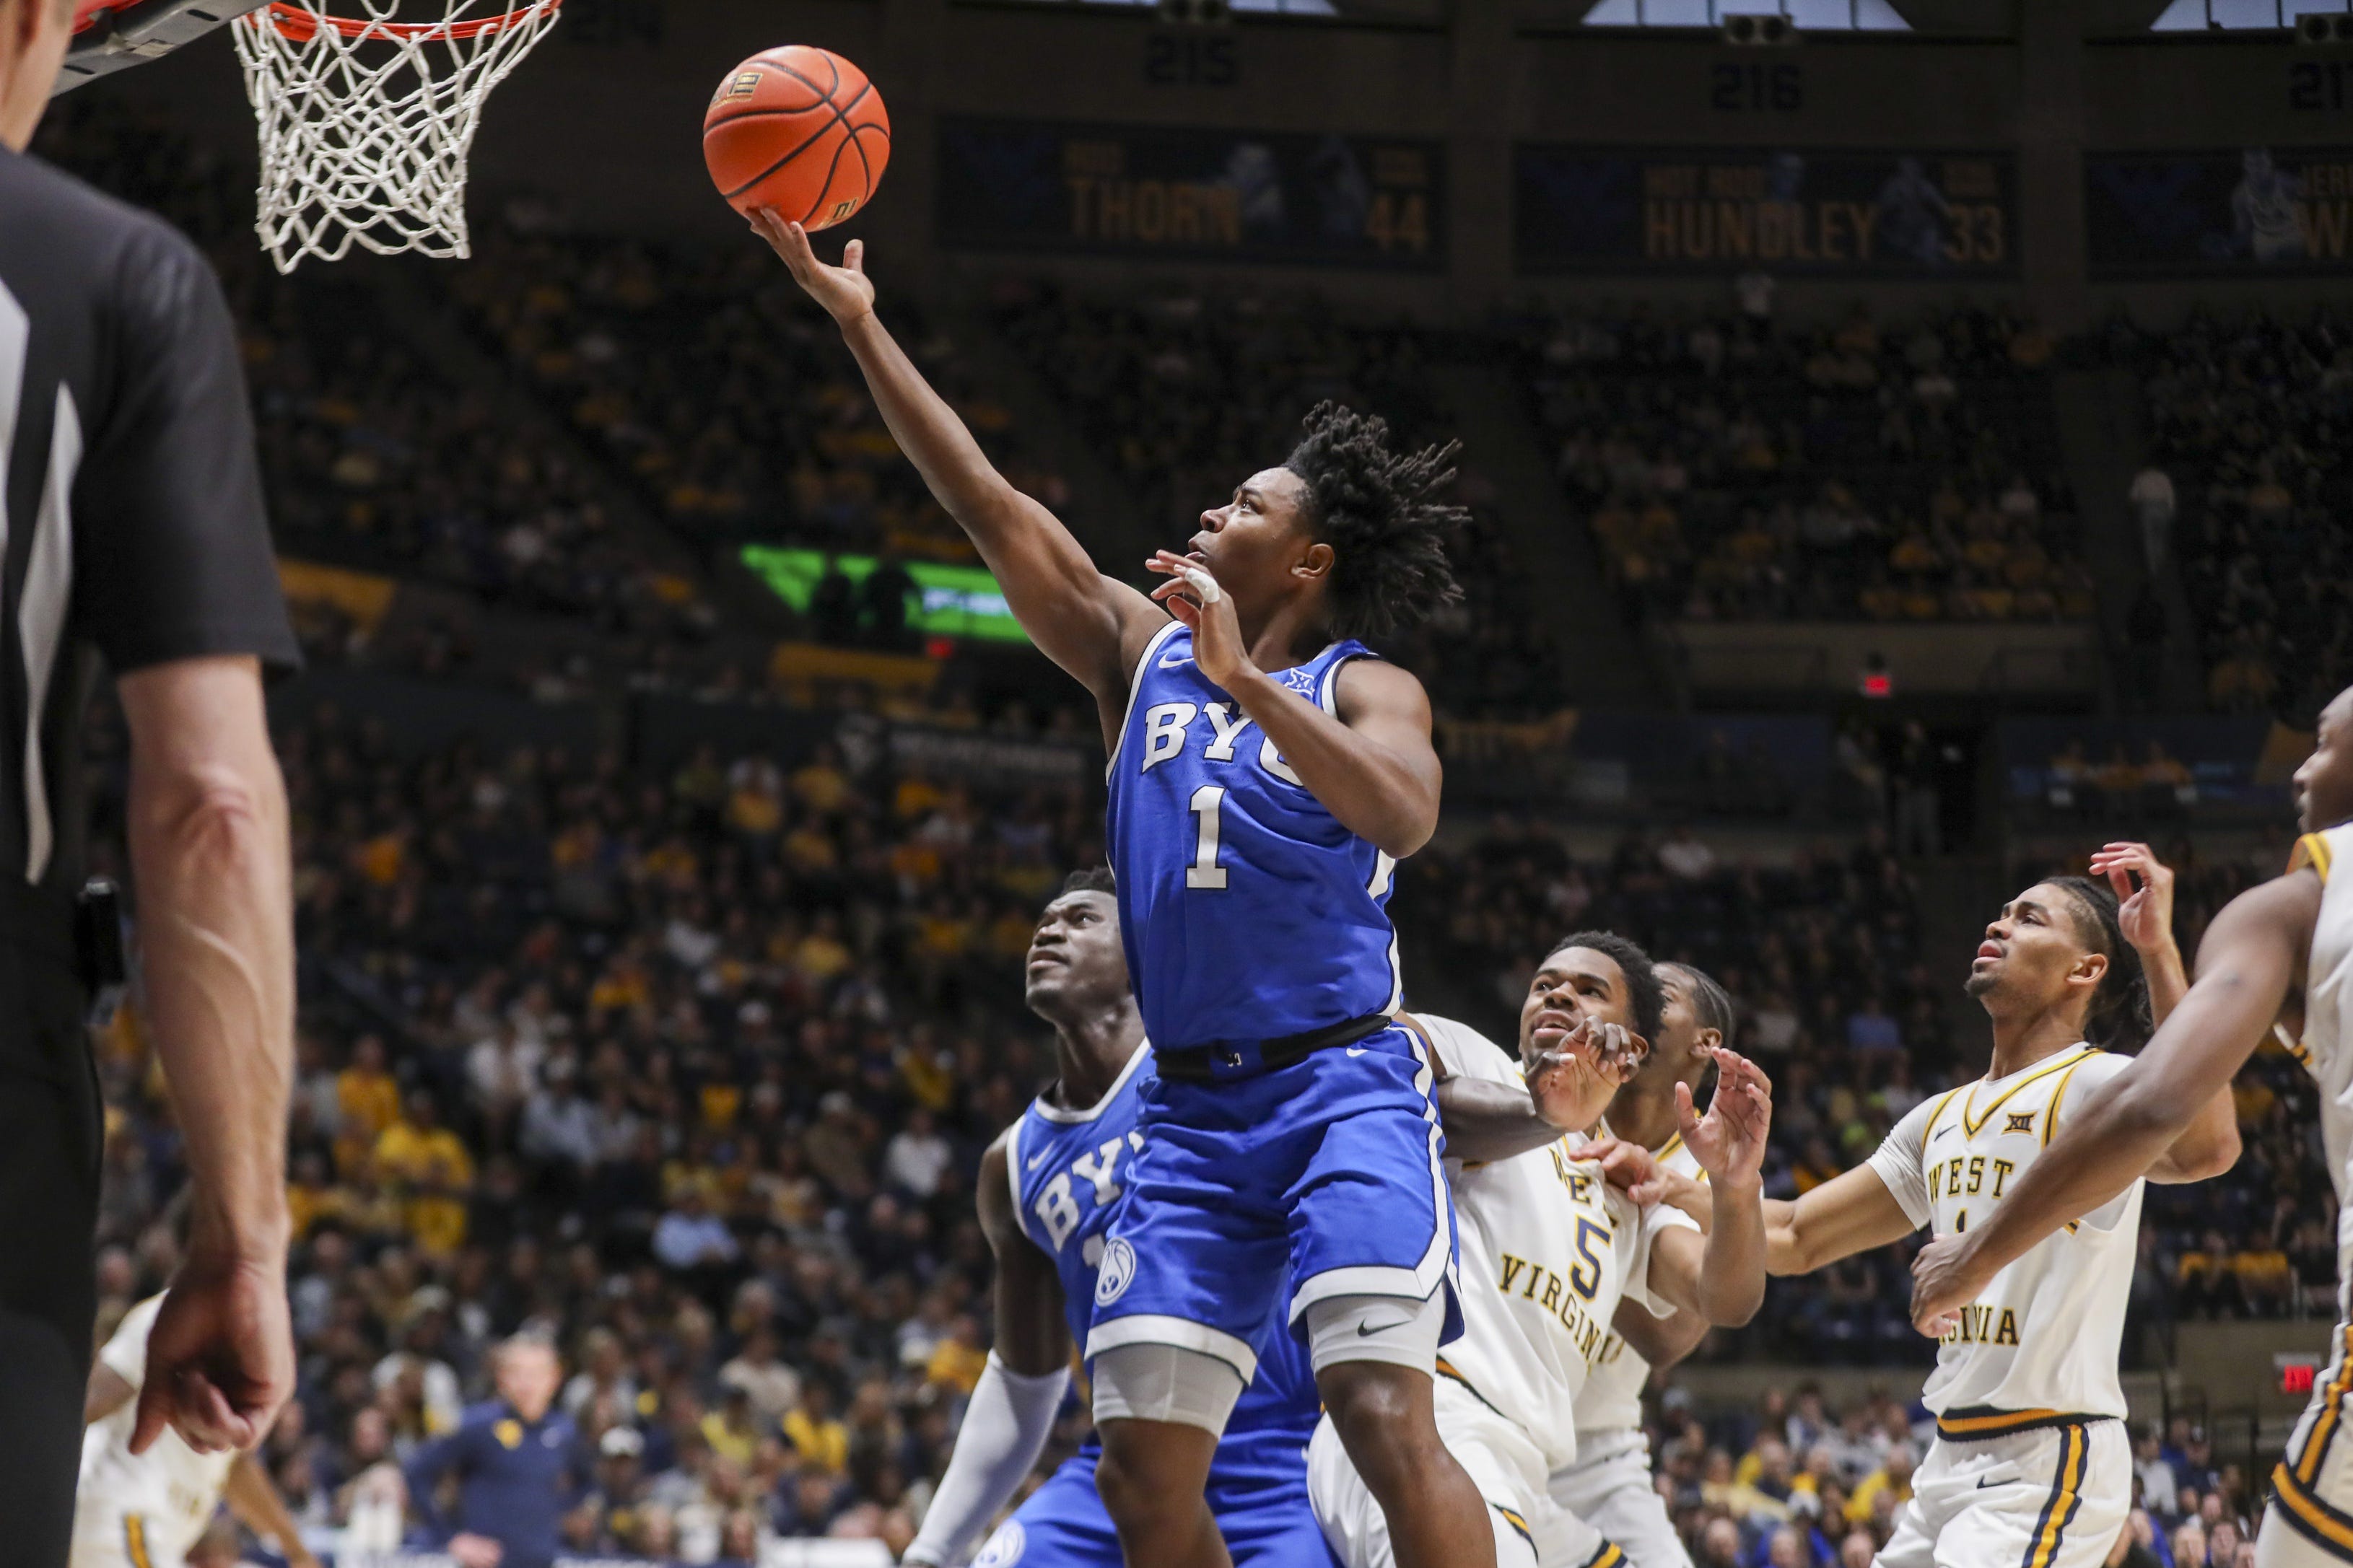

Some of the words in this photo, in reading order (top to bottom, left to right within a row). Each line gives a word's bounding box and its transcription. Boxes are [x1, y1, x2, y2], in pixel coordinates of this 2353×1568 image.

[1145, 33, 1238, 86] 215
[1710, 63, 1802, 111] 216
[2288, 60, 2353, 110] 21
[1065, 176, 1242, 245] THORN
[1363, 190, 1430, 253] 44
[1643, 198, 1882, 261] HUNDLEY
[1945, 202, 2007, 263] 33
[1186, 784, 1228, 889] 1
[1035, 1130, 1145, 1253] BY
[1929, 1156, 2015, 1204] WEST
[1569, 1214, 1613, 1303] 5
